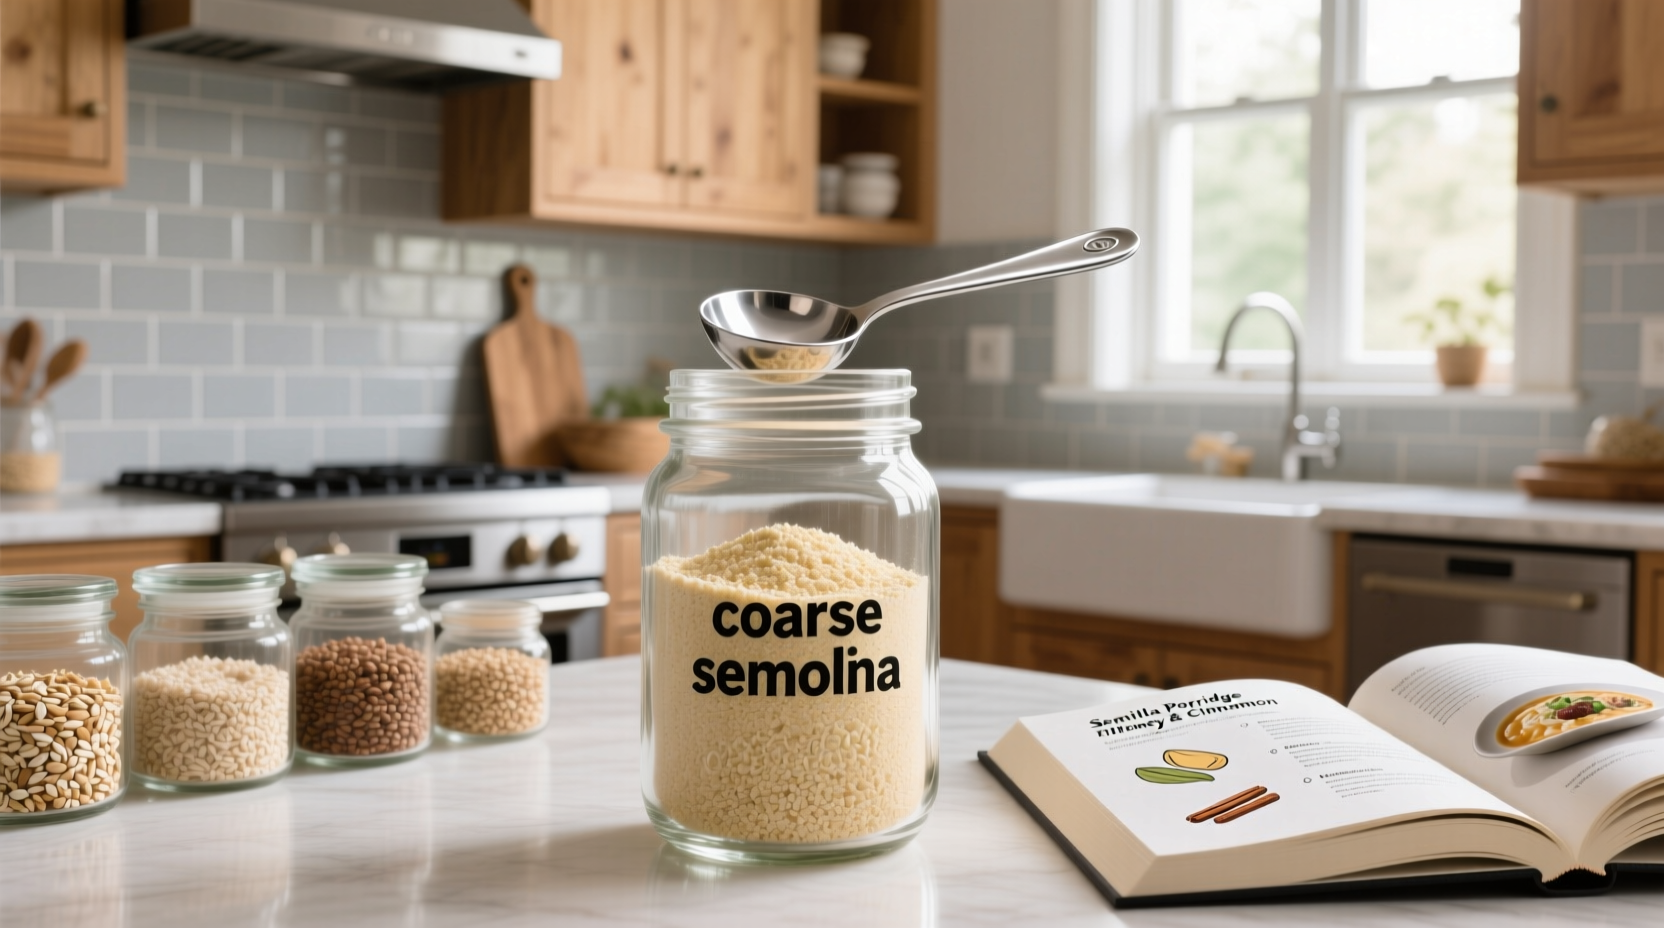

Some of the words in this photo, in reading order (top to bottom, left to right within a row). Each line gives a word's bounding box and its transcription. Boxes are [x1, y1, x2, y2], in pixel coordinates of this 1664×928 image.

[712, 599, 883, 639] coarse
[692, 646, 901, 697] semolina
[1162, 692, 1242, 713] Porridge
[1169, 712, 1183, 723] &
